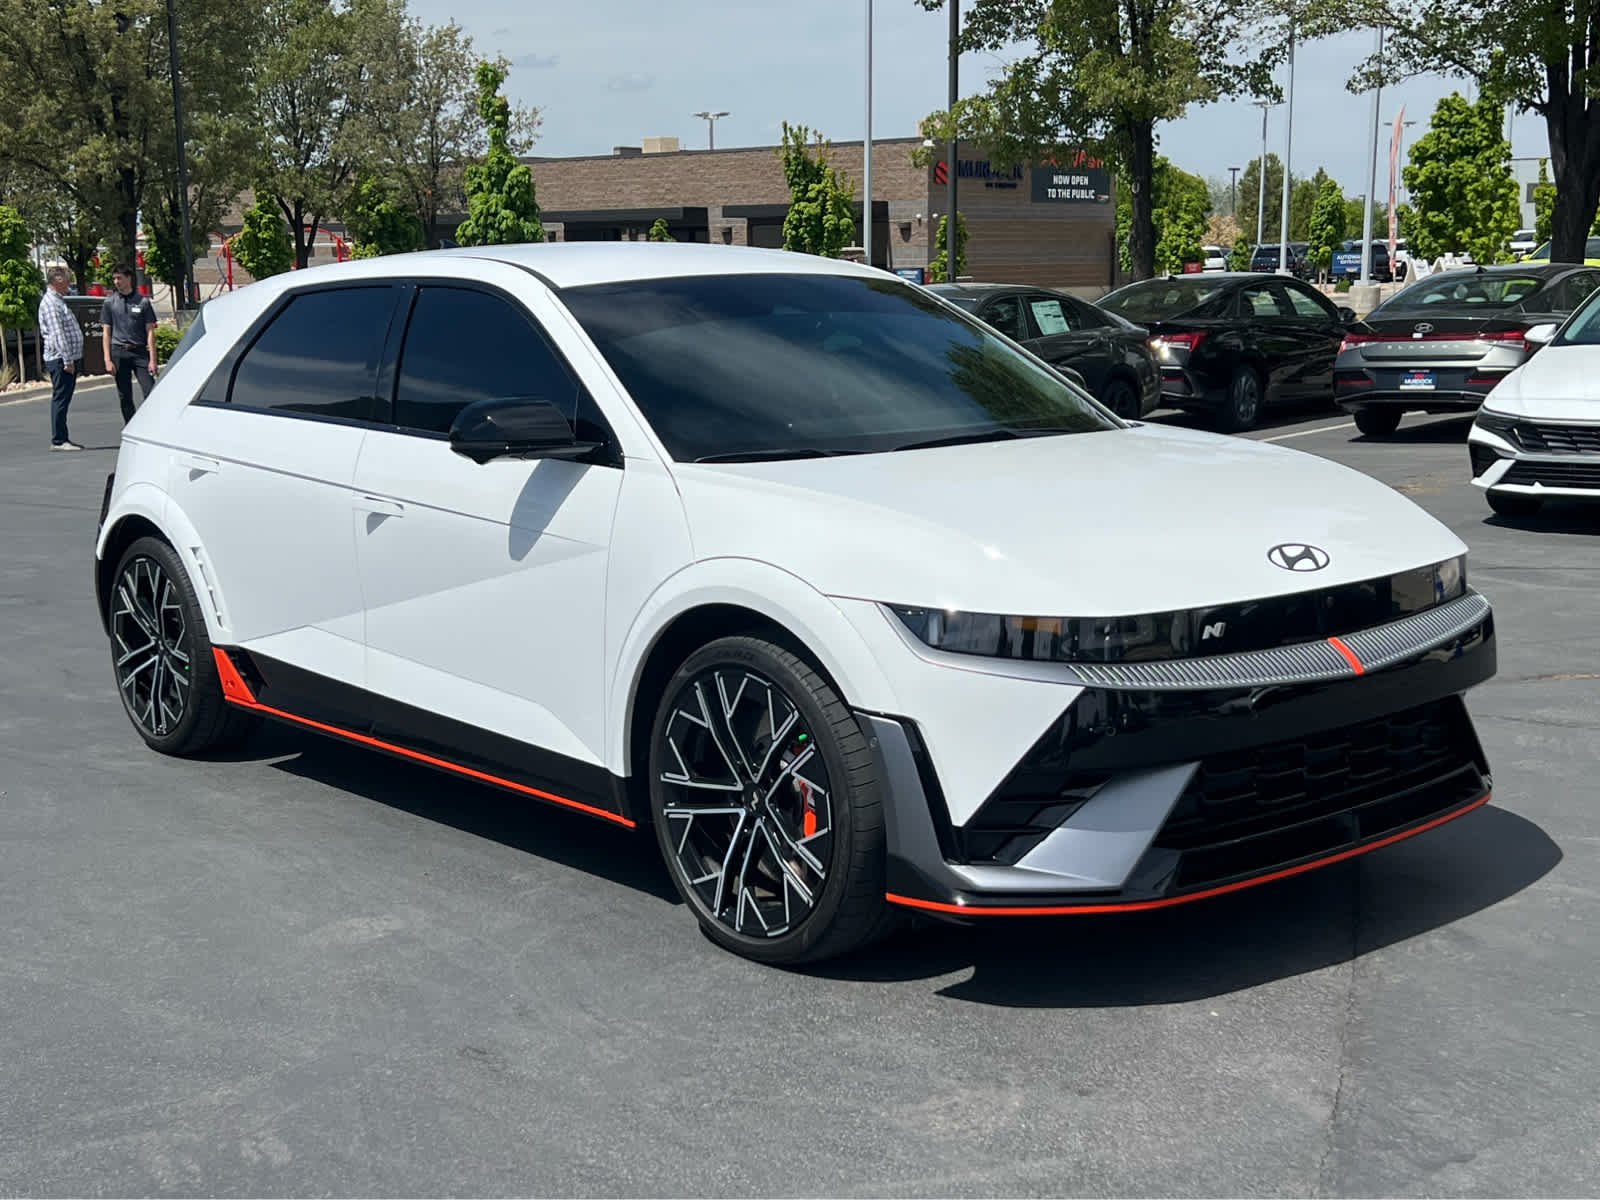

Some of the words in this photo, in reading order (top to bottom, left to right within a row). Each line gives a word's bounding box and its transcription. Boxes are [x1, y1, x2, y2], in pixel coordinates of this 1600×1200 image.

[1053, 175, 1070, 185] NOW
[1071, 175, 1089, 185] OPEN
[1047, 188, 1057, 198] TO
[1057, 188, 1071, 199] THE
[1071, 189, 1096, 199] PUBLIC
